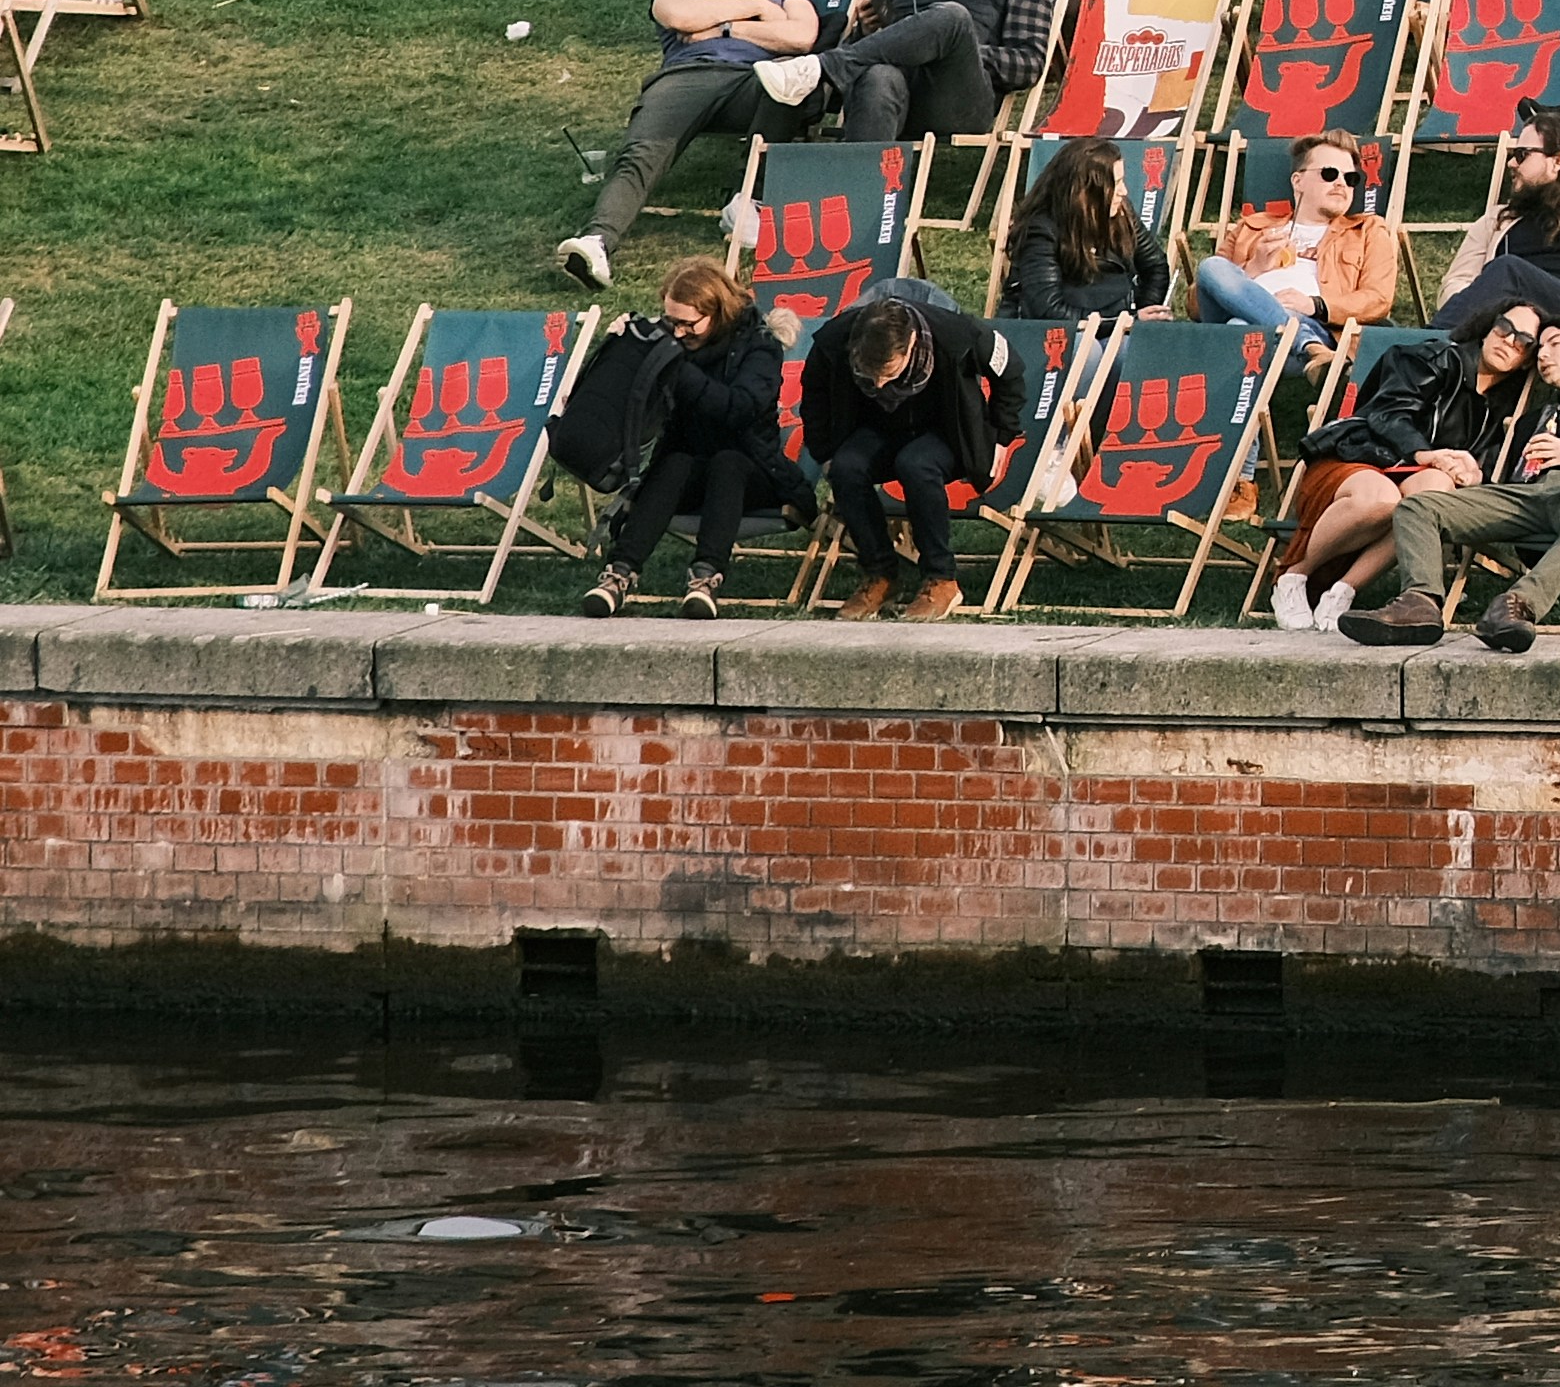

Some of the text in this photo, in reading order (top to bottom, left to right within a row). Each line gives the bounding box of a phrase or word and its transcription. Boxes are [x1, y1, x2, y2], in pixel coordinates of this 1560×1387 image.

[1095, 42, 1185, 74] DESPERADOS
[877, 193, 898, 244] BERLINER
[292, 355, 313, 406] BERLINER
[534, 355, 558, 406] BERLINER
[1035, 371, 1058, 420] BERLINER
[1231, 375, 1256, 424] BERLINER
